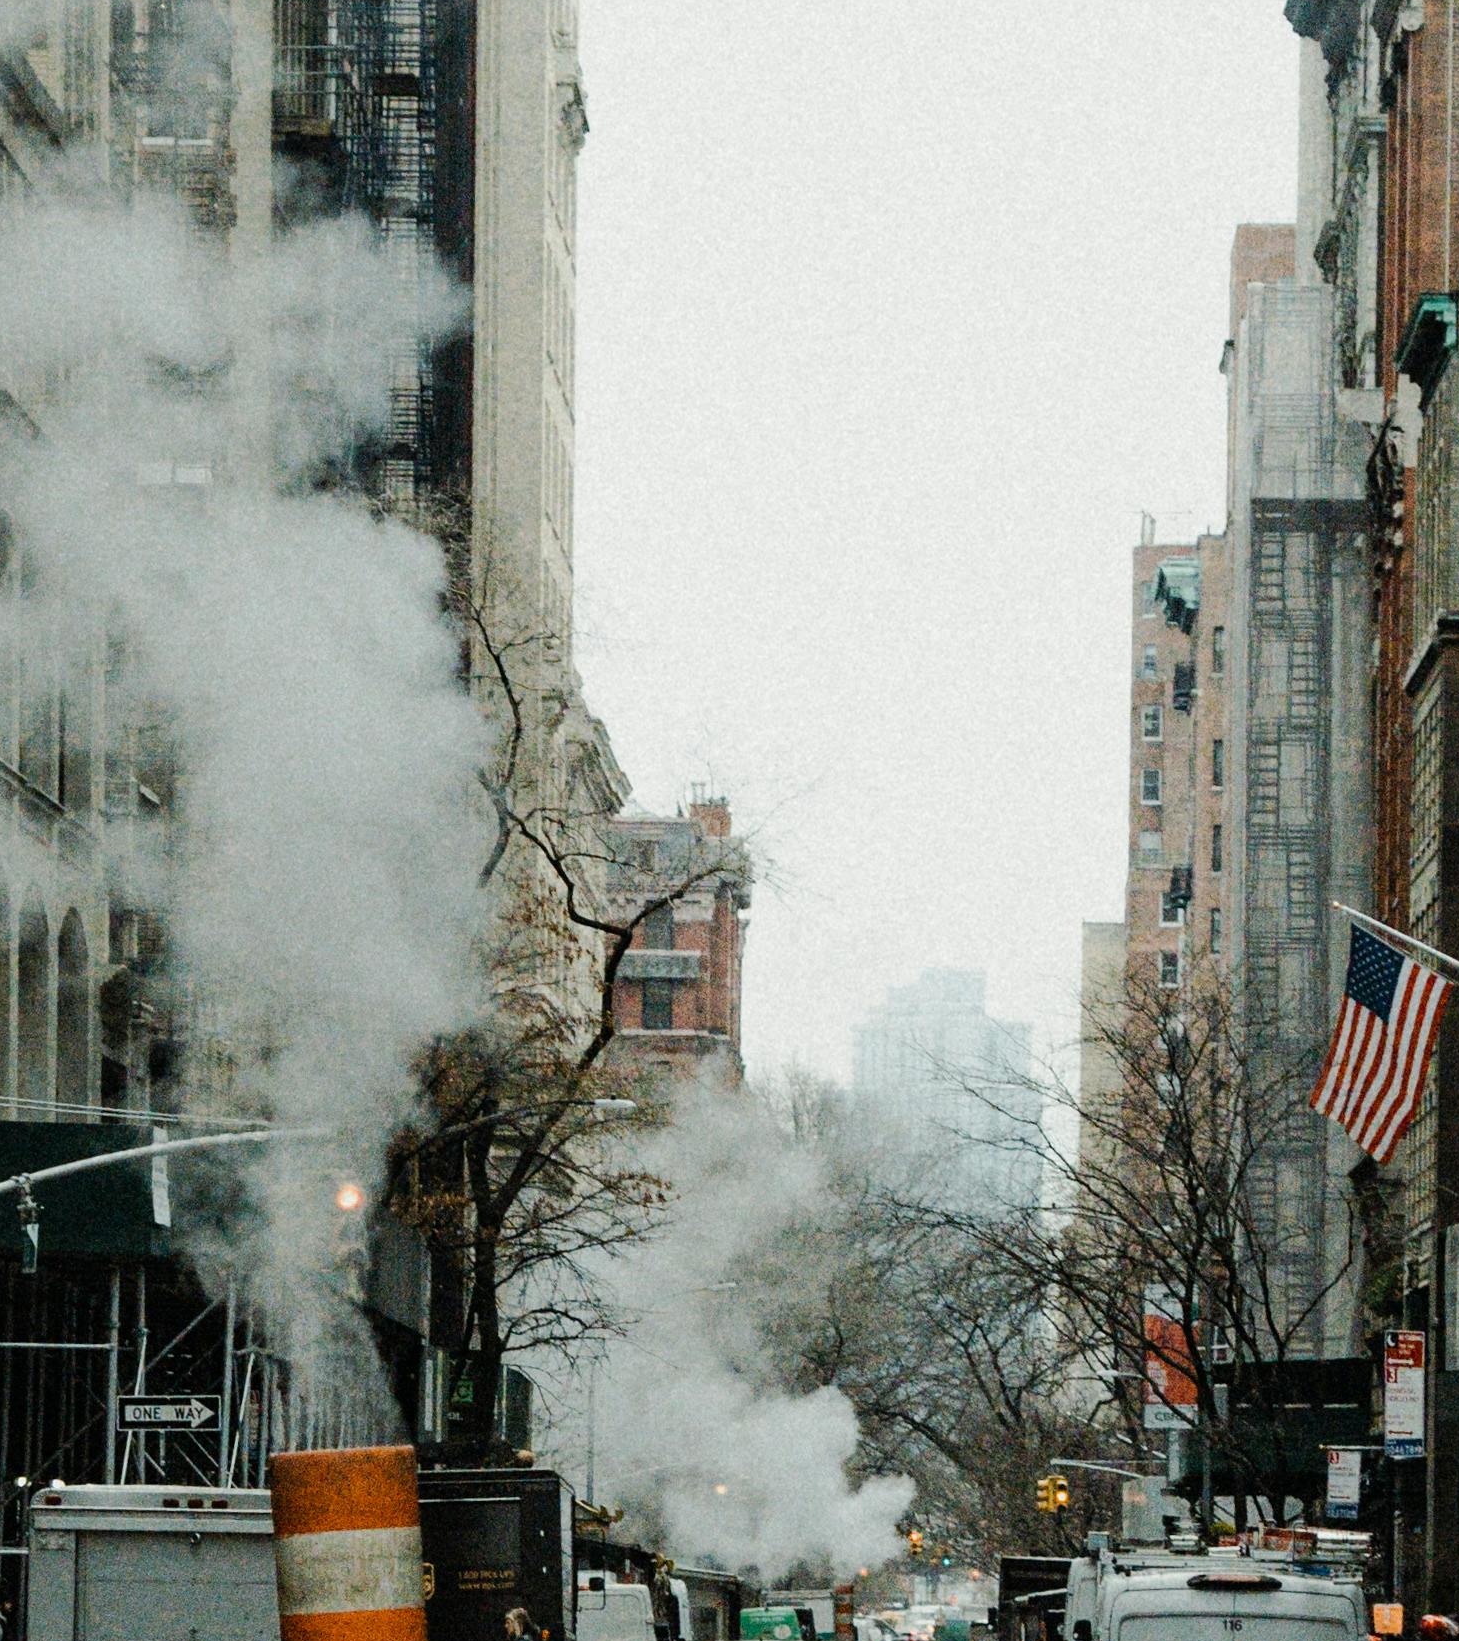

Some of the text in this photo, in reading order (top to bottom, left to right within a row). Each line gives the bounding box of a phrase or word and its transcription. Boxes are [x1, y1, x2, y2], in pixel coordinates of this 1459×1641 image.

[133, 1407, 204, 1420] ONE WAY
[1222, 1619, 1243, 1632] 116
